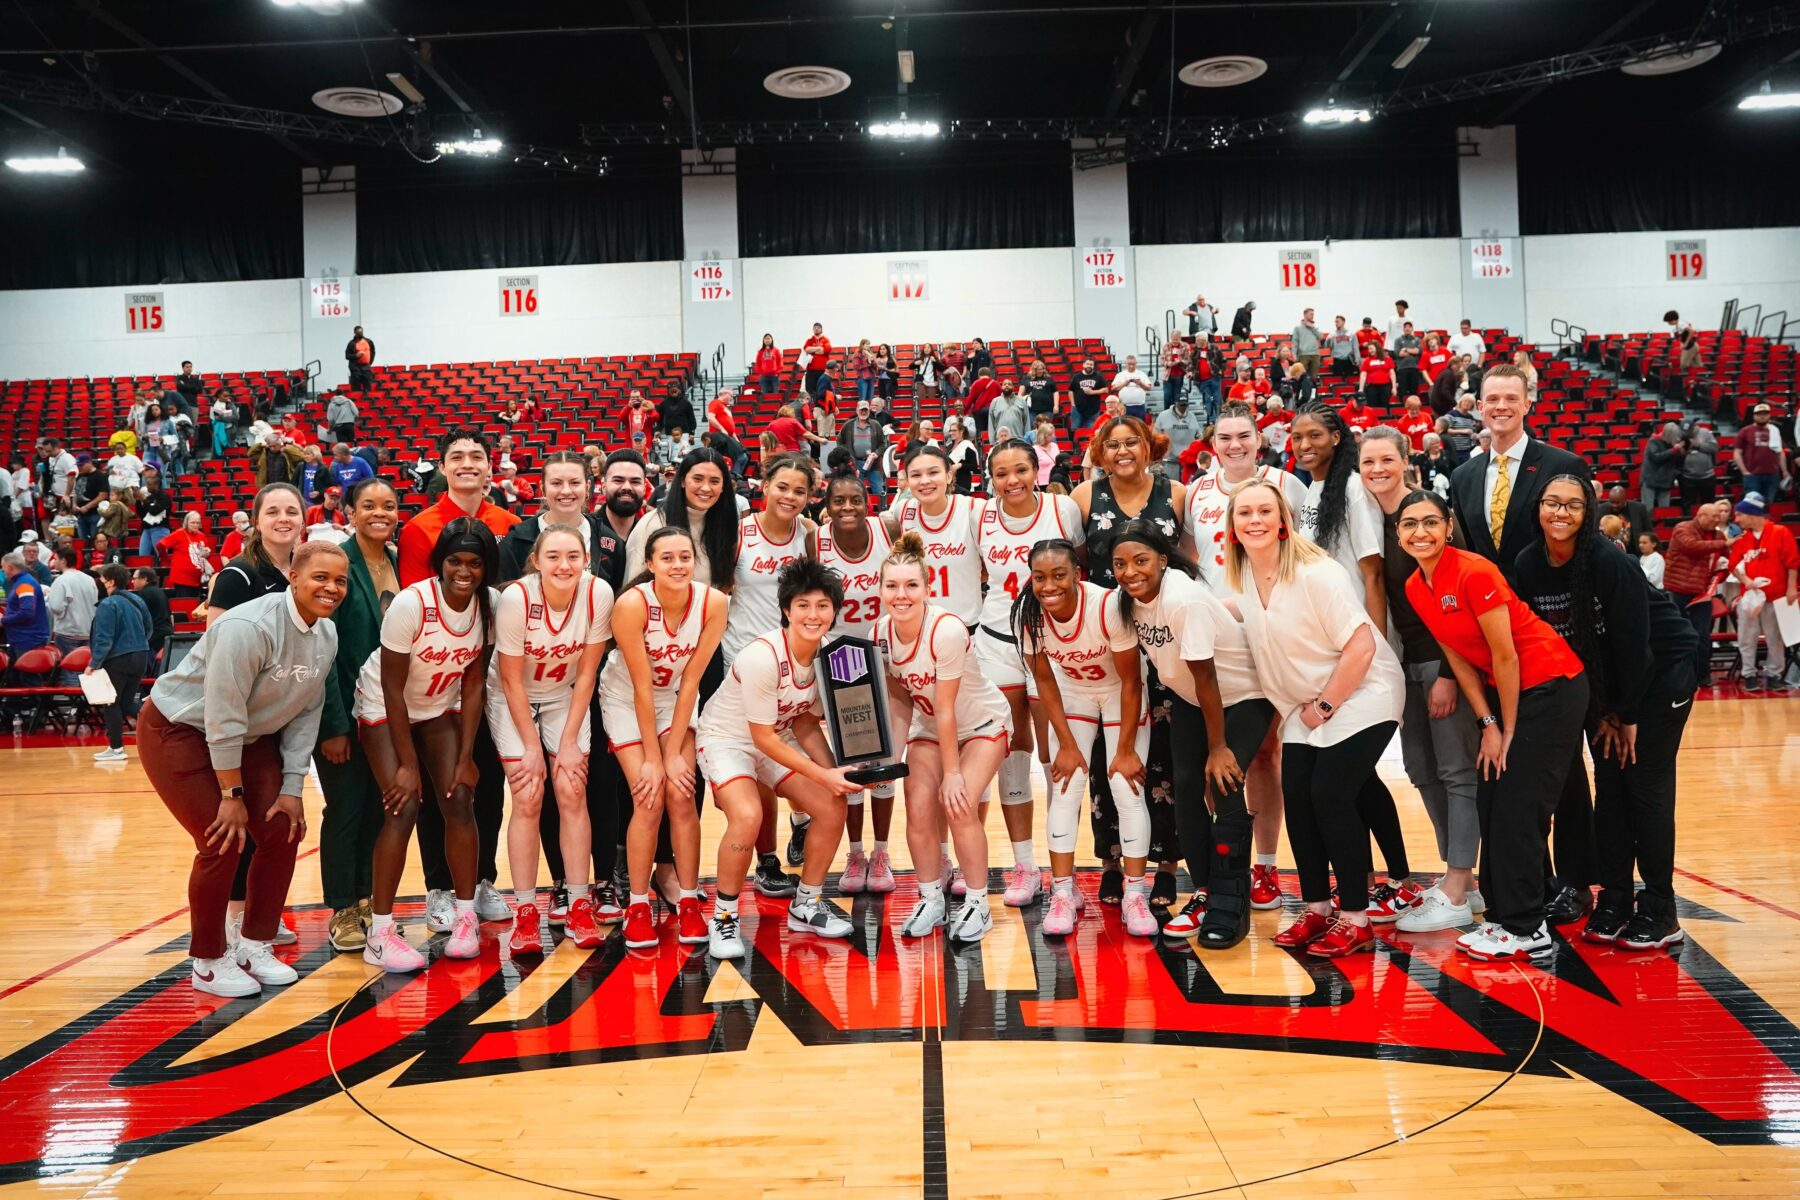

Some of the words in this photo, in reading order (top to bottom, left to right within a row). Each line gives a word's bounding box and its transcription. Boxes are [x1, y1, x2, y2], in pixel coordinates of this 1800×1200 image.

[1093, 253, 1115, 266] 117
[1481, 244, 1502, 257] 118
[701, 266, 722, 279] 116
[1482, 264, 1503, 277] 119
[1670, 253, 1703, 277] 119
[507, 278, 530, 287] SECTION
[1093, 273, 1115, 286] 118
[1282, 263, 1316, 287] 118
[320, 283, 341, 295] 115
[701, 287, 723, 299] 117
[891, 274, 926, 298] 117
[503, 288, 537, 312] 116
[129, 305, 162, 330] 115
[320, 304, 341, 316] 116
[1198, 506, 1225, 524] Lady
[928, 543, 966, 559] Rebels
[988, 545, 1012, 565] Lady
[751, 556, 778, 575] Lady
[854, 571, 879, 591] Reb
[1004, 572, 1019, 600] 4
[843, 596, 881, 623] 23
[416, 645, 451, 666] Lady
[1066, 645, 1107, 663] Rebels
[534, 662, 568, 682] 14
[830, 645, 868, 683] MW
[652, 666, 673, 687] 3
[841, 704, 872, 714] MOUNTAIN
[842, 711, 872, 725] WEST
